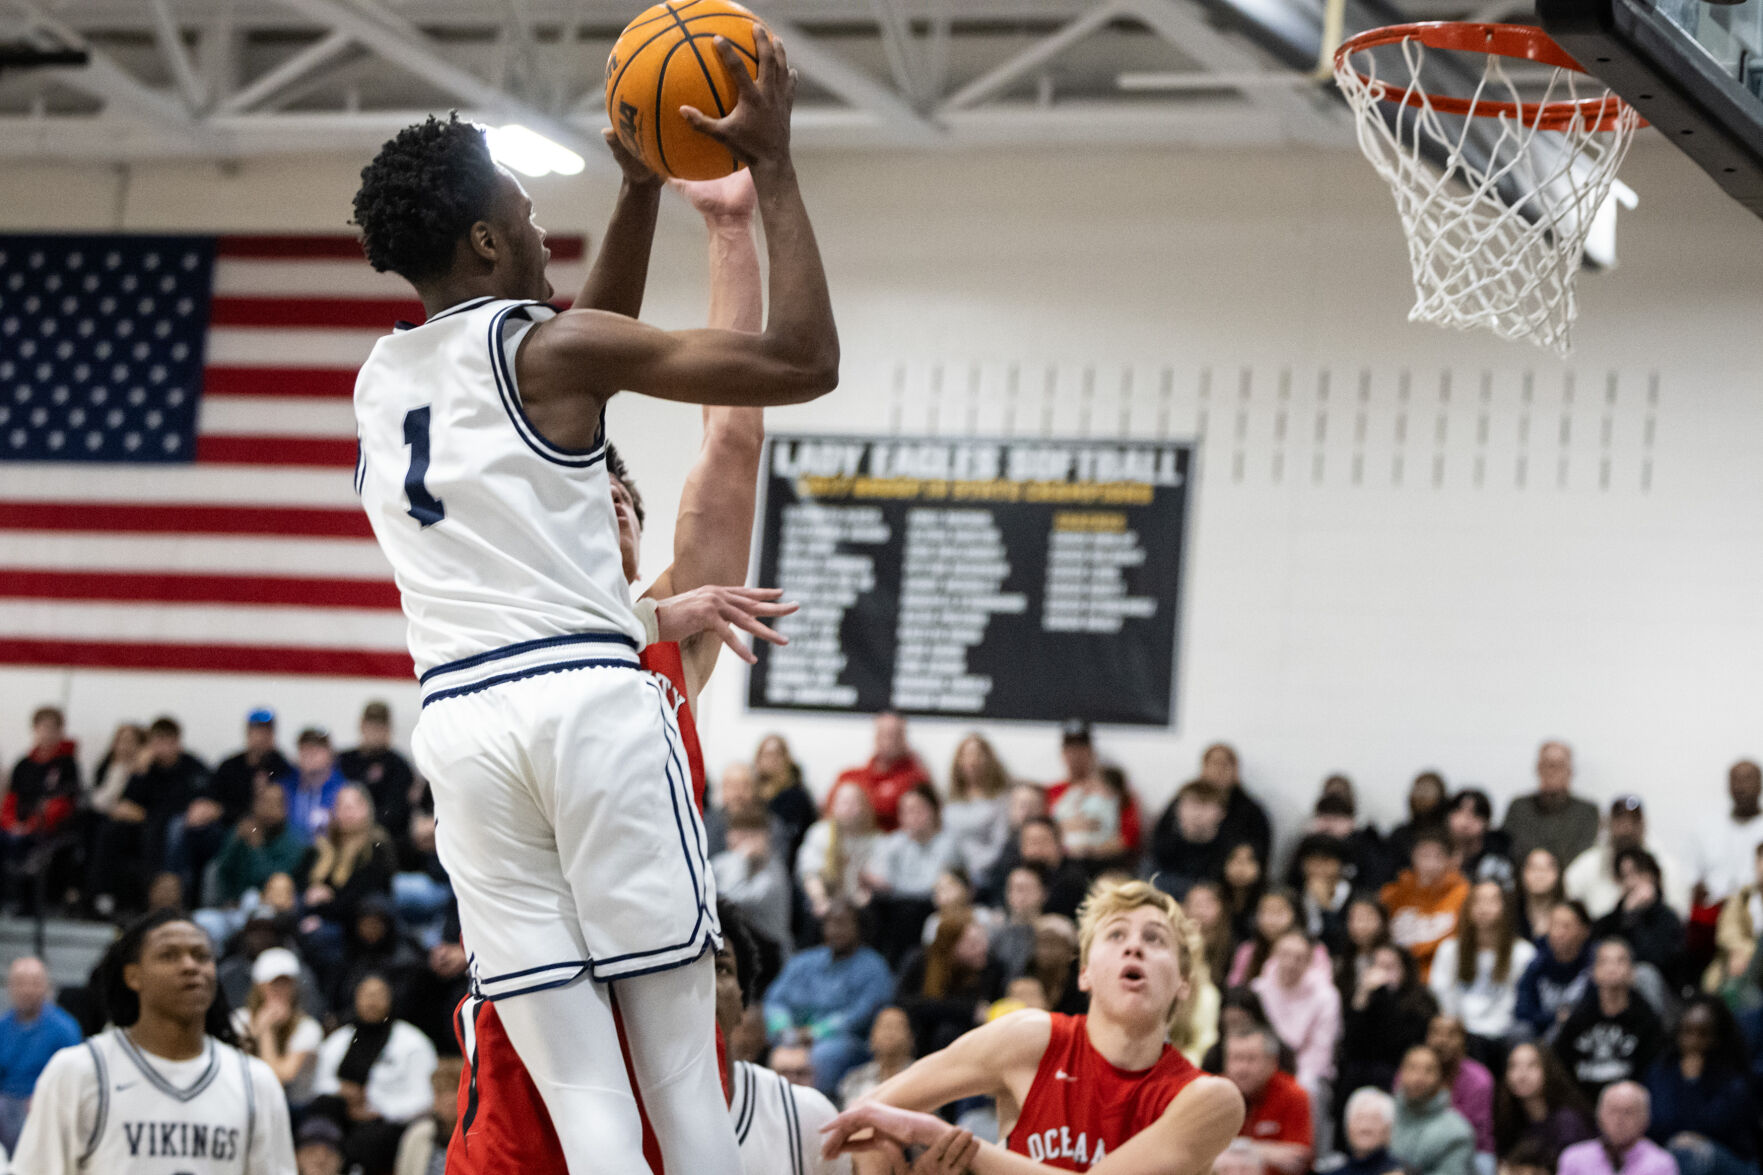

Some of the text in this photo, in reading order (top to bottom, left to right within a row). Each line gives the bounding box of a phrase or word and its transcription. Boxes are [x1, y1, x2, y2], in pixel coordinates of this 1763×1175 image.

[402, 402, 446, 529] 1
[773, 442, 1184, 487] LADY EAGLES SOFTBALL
[123, 1121, 240, 1161] VIKINGS
